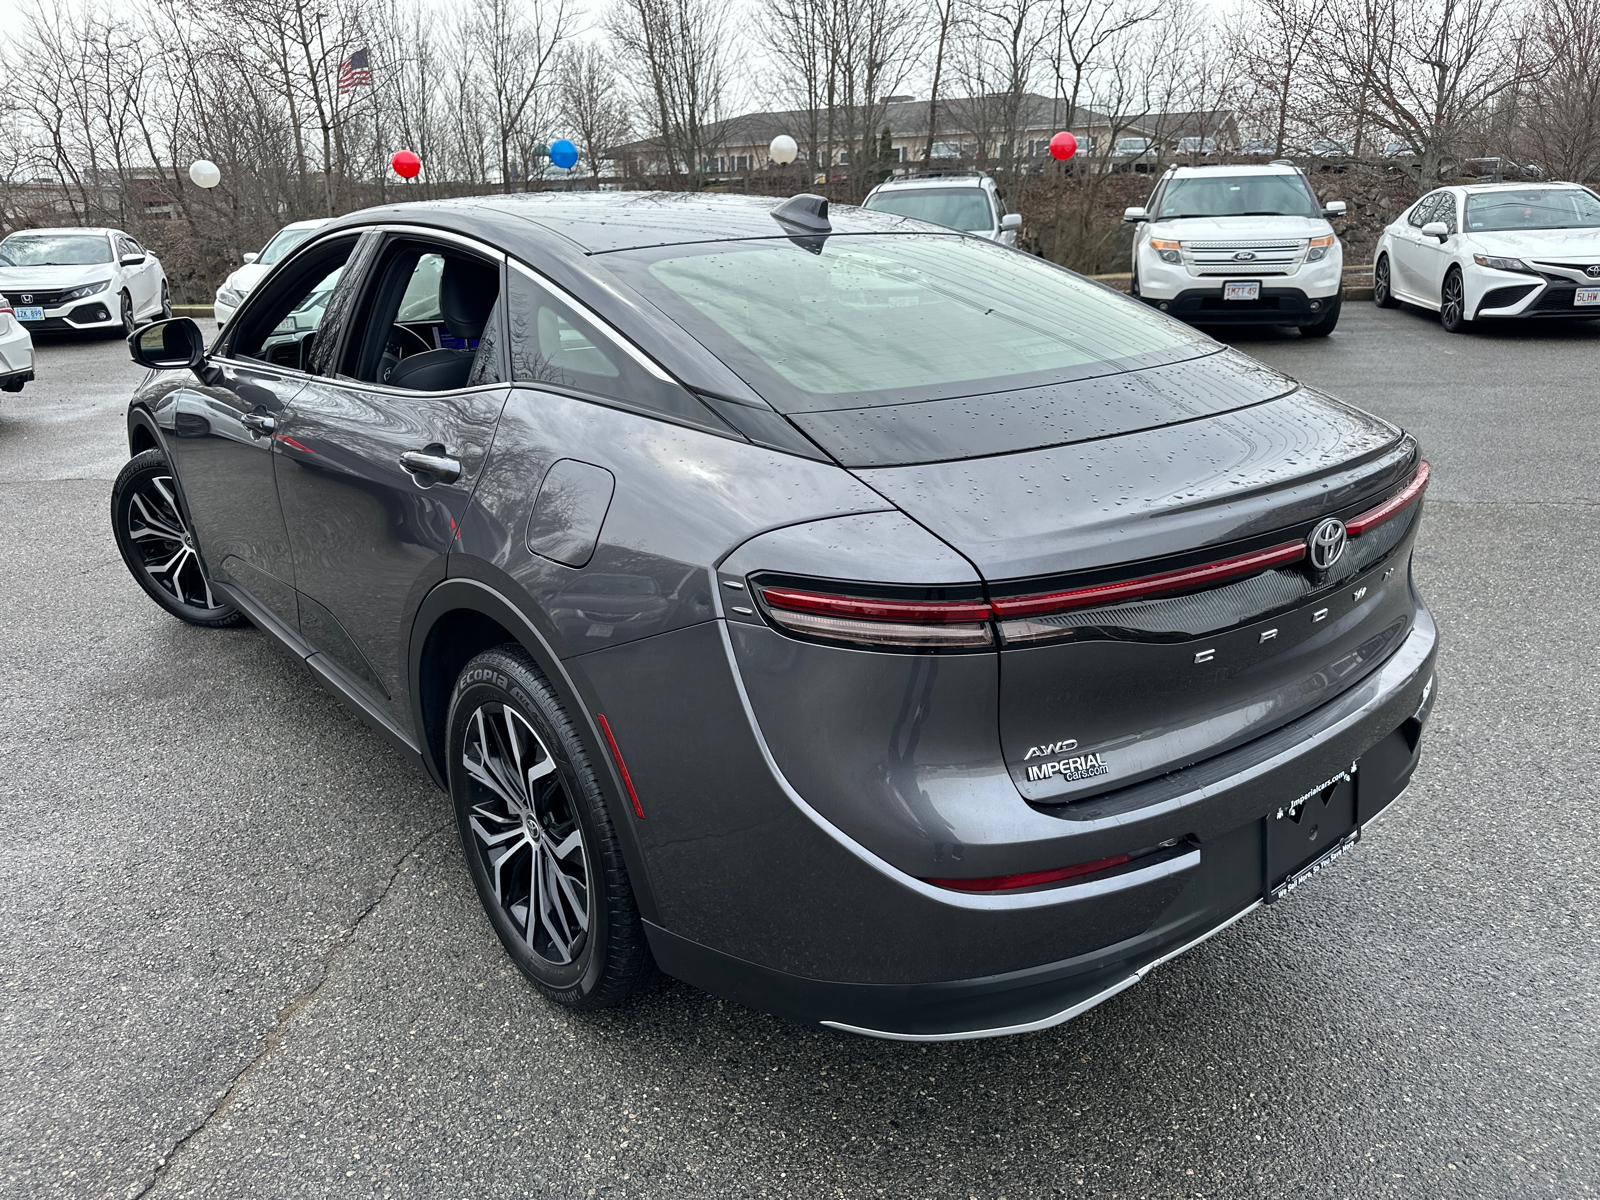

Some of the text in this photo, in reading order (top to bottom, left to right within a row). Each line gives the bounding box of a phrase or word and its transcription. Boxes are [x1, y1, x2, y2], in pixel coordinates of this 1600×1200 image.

[1226, 287, 1257, 296] 1MZT 49
[1576, 292, 1598, 301] 5LHW
[1194, 567, 1395, 664] CROWN
[460, 669, 509, 690] ECOPIA
[1023, 739, 1078, 760] AWD
[1027, 753, 1107, 781] IMPERIAL
[1066, 765, 1109, 781] cars.com
[1291, 771, 1345, 807] Imperialcars.com
